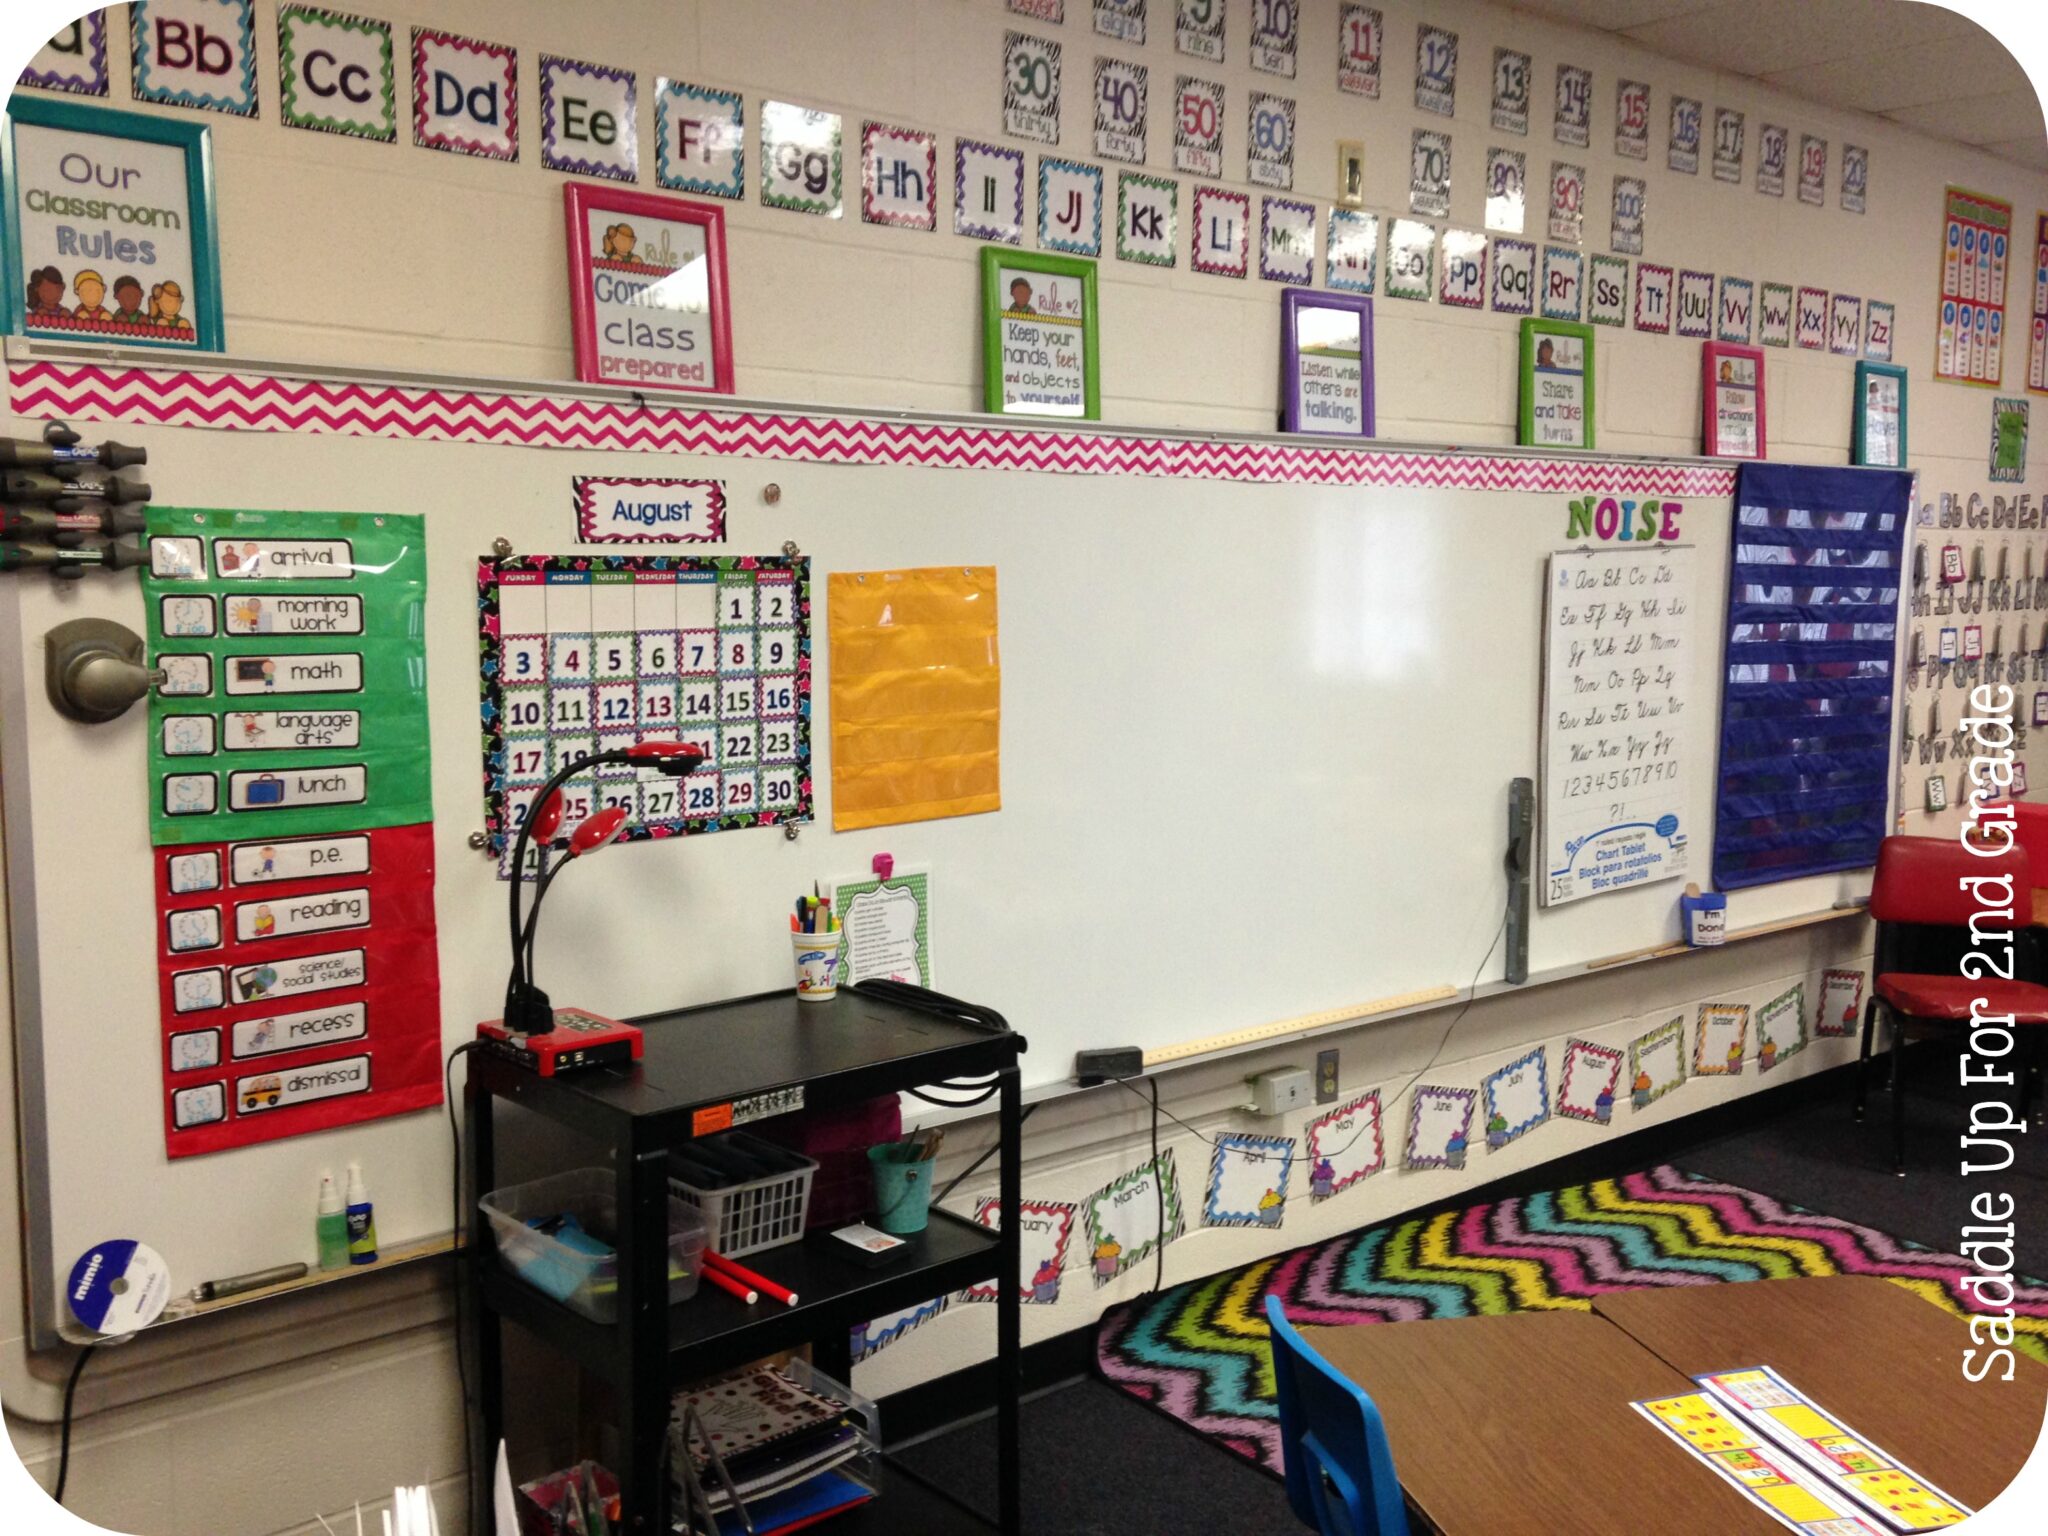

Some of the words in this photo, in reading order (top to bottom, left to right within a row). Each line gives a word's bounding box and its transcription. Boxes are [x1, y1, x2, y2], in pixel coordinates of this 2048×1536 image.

[1262, 0, 1291, 39] 10
[155, 16, 233, 76] Bb
[1350, 19, 1374, 61] 11
[1263, 51, 1285, 71] ten
[1427, 39, 1450, 82] 12
[302, 48, 372, 103] Cc
[1013, 52, 1050, 100] 30
[1501, 63, 1524, 101] 13
[434, 69, 498, 126] Dd
[1103, 75, 1138, 123] 40
[1564, 77, 1586, 119] 14
[1624, 93, 1646, 128] 15
[562, 96, 618, 146] Ee
[1012, 114, 1050, 137] thirty
[1182, 94, 1216, 139] 50
[1256, 109, 1286, 152] 60
[1675, 108, 1696, 143] 16
[1105, 132, 1135, 156] forty
[1718, 119, 1740, 153] 17
[1418, 145, 1444, 183] 70
[1765, 136, 1782, 167] 18
[1806, 147, 1822, 177] 19
[59, 151, 142, 190] Our
[776, 141, 829, 195] Gg
[877, 157, 923, 202] Hh
[1494, 162, 1517, 197] 80
[1846, 156, 1863, 187] 20
[1556, 176, 1579, 212] 90
[1616, 192, 1640, 220] 100
[25, 189, 181, 231] Classroom
[1056, 190, 1082, 234] Jj
[1131, 202, 1163, 241] Kk
[56, 224, 157, 265] Rules
[644, 228, 678, 267] Rule
[1211, 216, 1232, 251] Ll
[1450, 255, 1478, 292] Pp
[1500, 263, 1528, 299] Qq
[1549, 270, 1574, 299] Rr
[1038, 282, 1062, 315] Rule
[1597, 277, 1620, 306] Ss
[1646, 285, 1663, 314] Tt
[1684, 291, 1706, 320] Uu
[1724, 298, 1747, 325] Vv
[1764, 305, 1789, 327] Ww
[1802, 310, 1821, 332] Xx
[604, 317, 695, 351] class
[1008, 323, 1039, 346] Keep
[1042, 330, 1075, 347] your
[1836, 314, 1856, 343] Yy
[1871, 319, 1888, 344] Zz
[600, 354, 704, 382] prepared
[1004, 344, 1051, 368] hands,
[1056, 349, 1080, 372] feet,
[1301, 361, 1333, 378] Listen
[1005, 372, 1019, 384] and
[1022, 371, 1080, 389] objects
[1304, 380, 1342, 397] others
[1542, 380, 1574, 399] Share
[1305, 400, 1357, 423] talking.
[1535, 405, 1554, 418] and
[612, 499, 692, 525] August
[1566, 496, 1683, 541] NOISE
[1940, 492, 1963, 528] Bb
[1992, 495, 2018, 529] Dd
[2018, 493, 2039, 529] Ee
[271, 548, 333, 566] arrival
[504, 573, 537, 582] SUNDAY
[551, 573, 584, 582] MONDAY
[595, 573, 627, 581] TUESDAY
[635, 572, 676, 581] WEDNESDAY
[678, 572, 714, 581] THURSDAY
[723, 572, 748, 580] FRIDAY
[757, 572, 791, 580] SATURDAY
[277, 598, 348, 618] morning
[731, 599, 742, 619] 1
[771, 597, 783, 617] 2
[290, 617, 336, 631] work
[291, 660, 343, 679] math
[516, 651, 530, 674] 3
[565, 650, 580, 672] 4
[608, 649, 621, 671] 5
[652, 647, 665, 669] 6
[691, 646, 704, 667] 7
[732, 644, 744, 665] 8
[770, 642, 783, 664] 9
[511, 702, 540, 725] 10
[557, 700, 584, 721] 11
[603, 698, 629, 720] 12
[646, 696, 672, 717] 13
[686, 693, 711, 715] 14
[726, 691, 750, 712] 15
[767, 688, 791, 709] 16
[276, 712, 352, 731] language
[295, 729, 332, 746] arts
[513, 750, 541, 773] 17
[727, 736, 751, 757] 22
[767, 733, 790, 753] 23
[298, 773, 346, 794] lunch
[649, 792, 673, 813] 27
[689, 788, 714, 809] 28
[728, 783, 751, 805] 29
[767, 780, 791, 801] 30
[310, 847, 343, 867] p.e.
[1596, 848, 1619, 861] Chart
[1622, 842, 1646, 856] Tablet
[1579, 865, 1600, 879] Block
[1603, 862, 1622, 875] para
[1592, 878, 1610, 889] Bloc
[1551, 879, 1563, 900] 25
[290, 897, 361, 922] reading
[282, 973, 313, 988] social
[321, 966, 361, 982] studies
[290, 1012, 354, 1038] recess
[1711, 1015, 1736, 1027] October
[1765, 1000, 1795, 1022] November
[1639, 1032, 1677, 1058] September
[1582, 1055, 1607, 1070] August
[287, 1064, 361, 1093] dismissal
[1508, 1072, 1524, 1088] July
[1433, 1101, 1452, 1112] June
[1336, 1117, 1355, 1132] May
[1242, 1151, 1266, 1164] April
[1113, 1179, 1149, 1208] March
[74, 1253, 104, 1300] mimio
